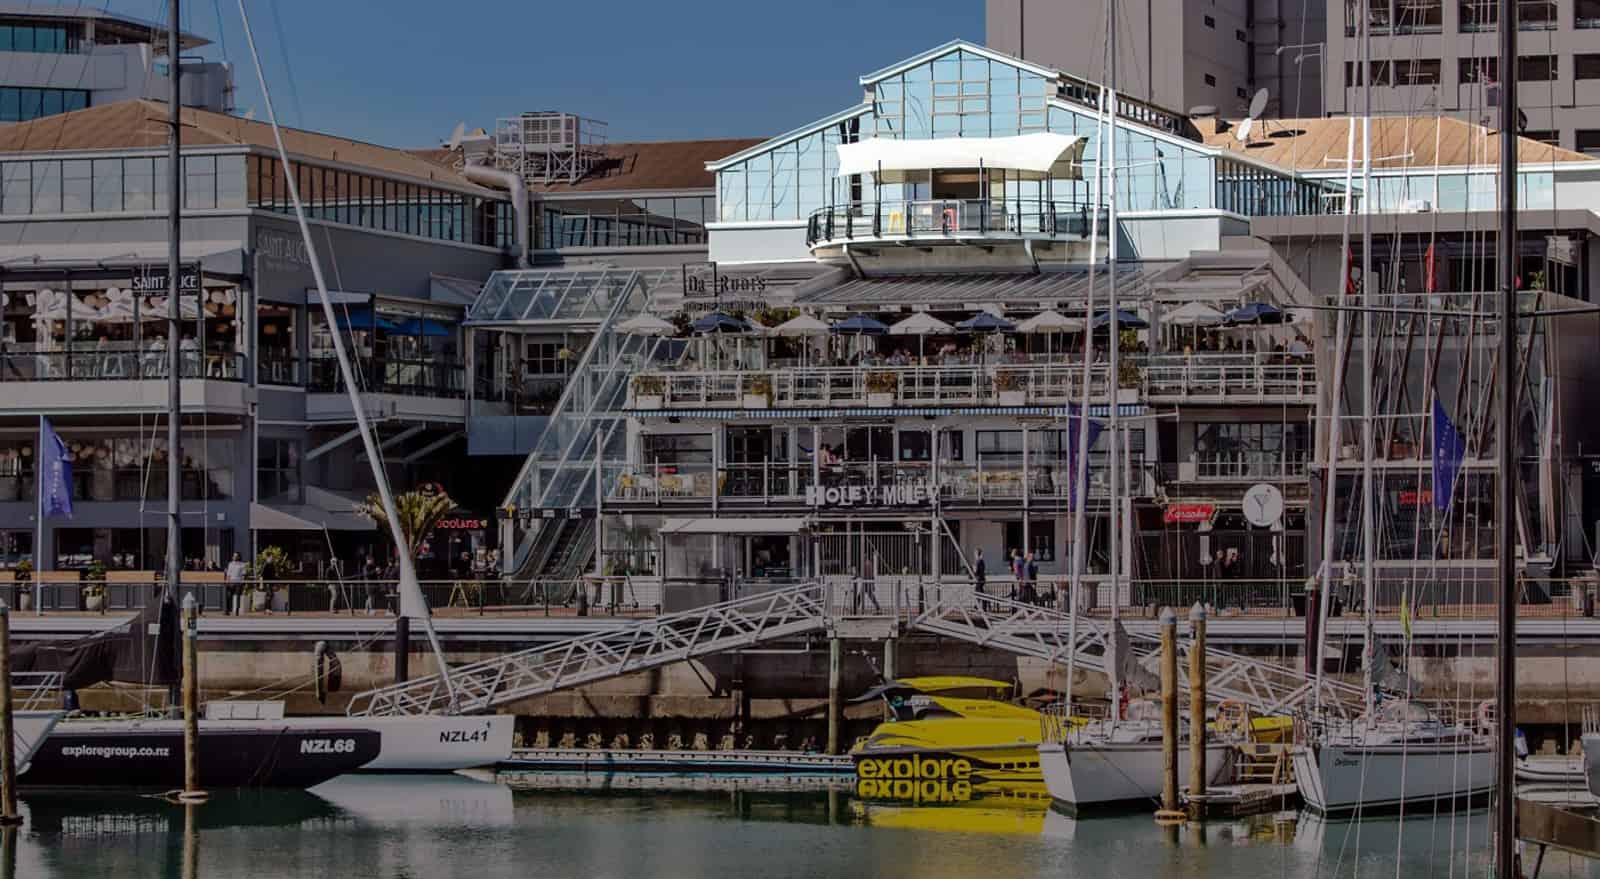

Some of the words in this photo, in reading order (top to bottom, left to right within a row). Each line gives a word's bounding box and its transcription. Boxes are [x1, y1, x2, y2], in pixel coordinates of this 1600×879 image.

[133, 275, 165, 290] SAINT
[806, 485, 875, 506] HOLEY
[882, 485, 940, 505] MOLEY
[440, 730, 488, 743] NZL41
[61, 744, 170, 758] exploregroup.co.nz
[300, 739, 355, 753] NZL68
[858, 754, 972, 779] explore
